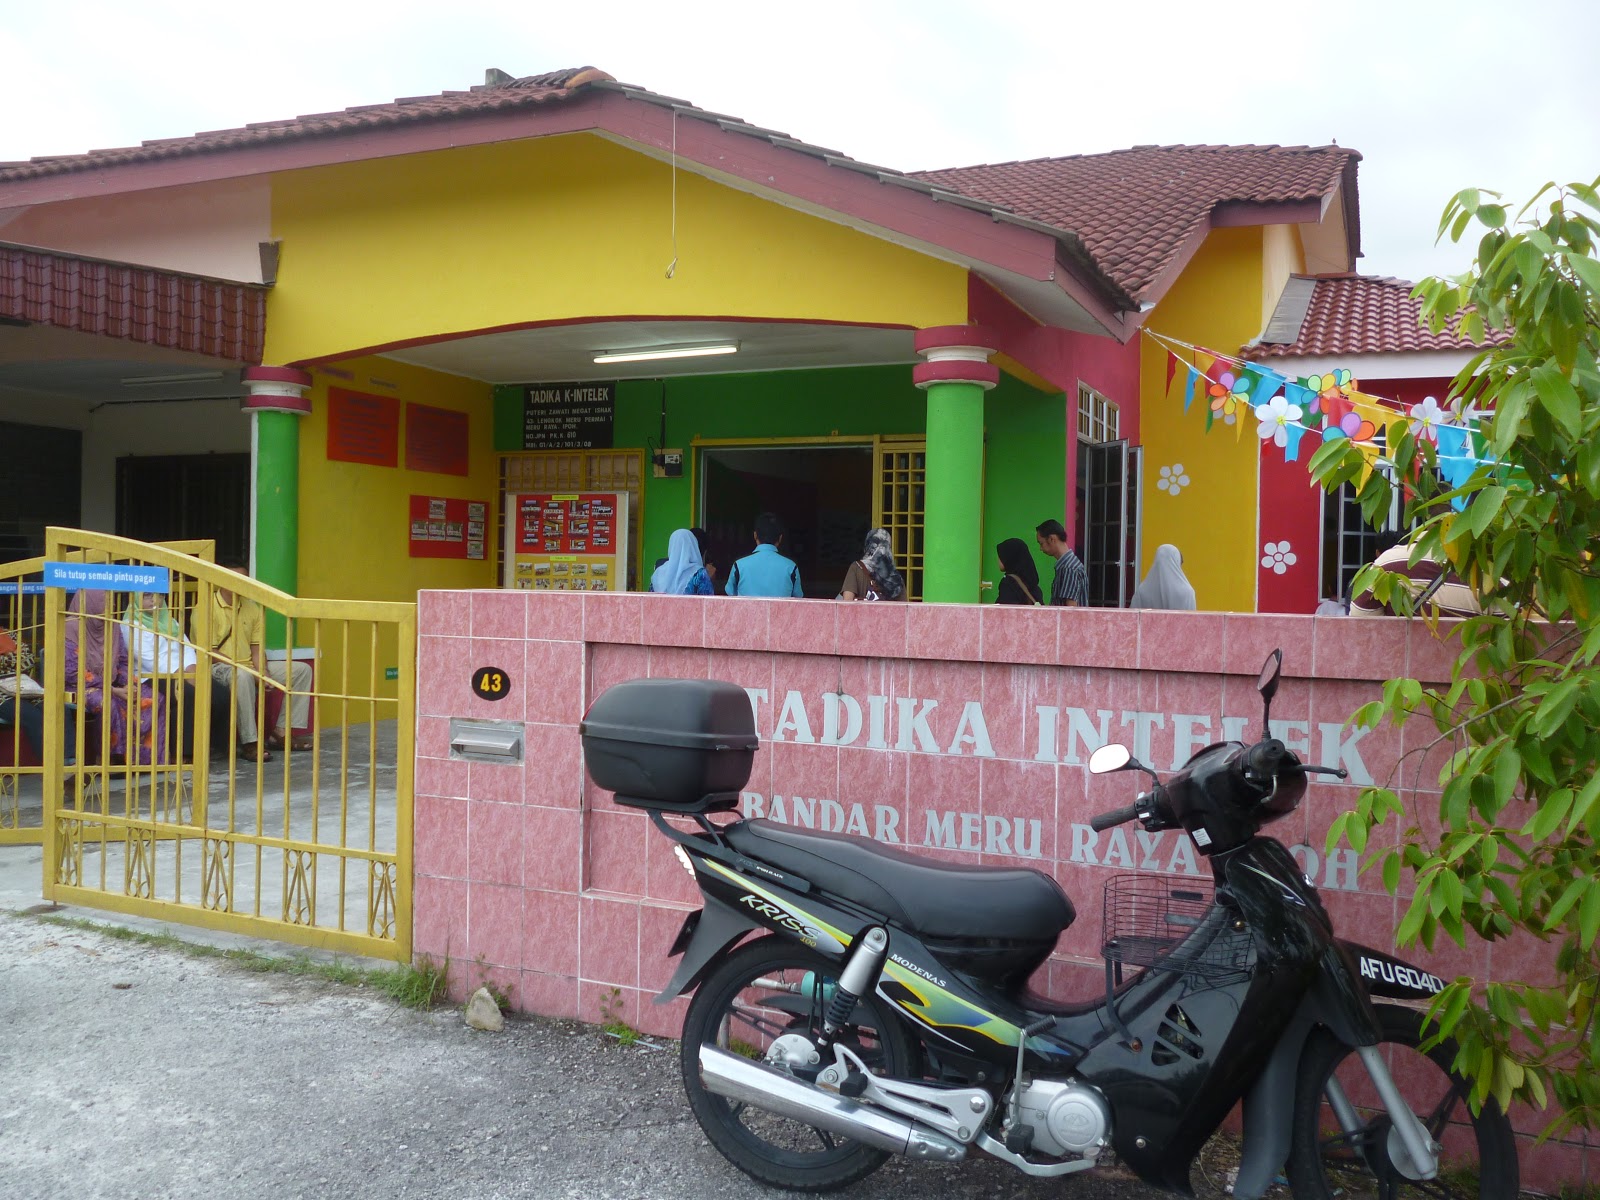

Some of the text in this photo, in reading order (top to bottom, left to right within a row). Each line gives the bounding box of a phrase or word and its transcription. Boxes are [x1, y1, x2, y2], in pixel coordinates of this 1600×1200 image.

[530, 387, 609, 404] TADIKA K-INTELEK
[54, 568, 156, 585] Sila tutup semula pintu pagar
[480, 672, 502, 692] 43
[743, 687, 996, 758] TADIKA
[742, 791, 900, 843] BANDAR
[923, 809, 1042, 858] MERU
[1070, 822, 1200, 875] RAYA
[739, 894, 822, 939] KRISS
[799, 936, 817, 948] 100
[890, 953, 947, 988] MODENAS
